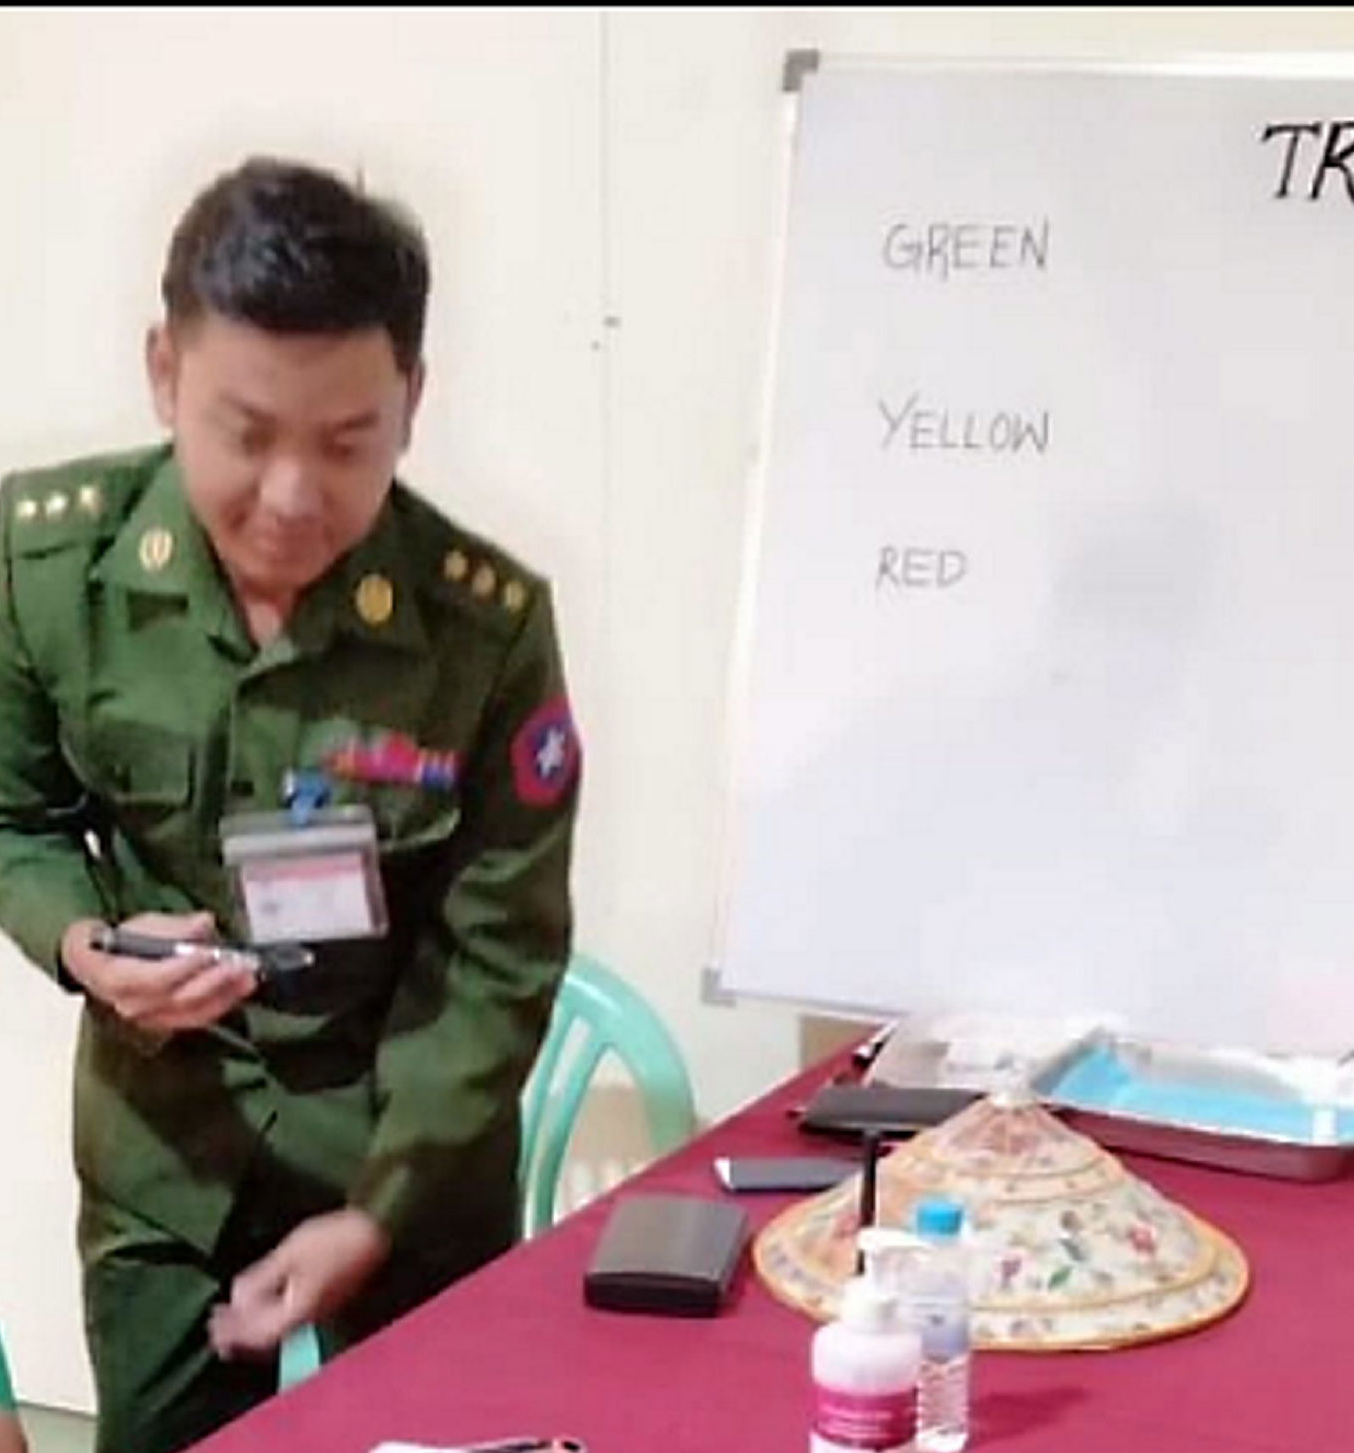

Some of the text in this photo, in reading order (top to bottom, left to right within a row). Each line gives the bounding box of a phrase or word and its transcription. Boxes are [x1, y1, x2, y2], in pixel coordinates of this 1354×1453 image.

[881, 219, 1049, 278] GREEN
[877, 395, 1049, 454] YELLOW
[874, 544, 967, 589] RED
